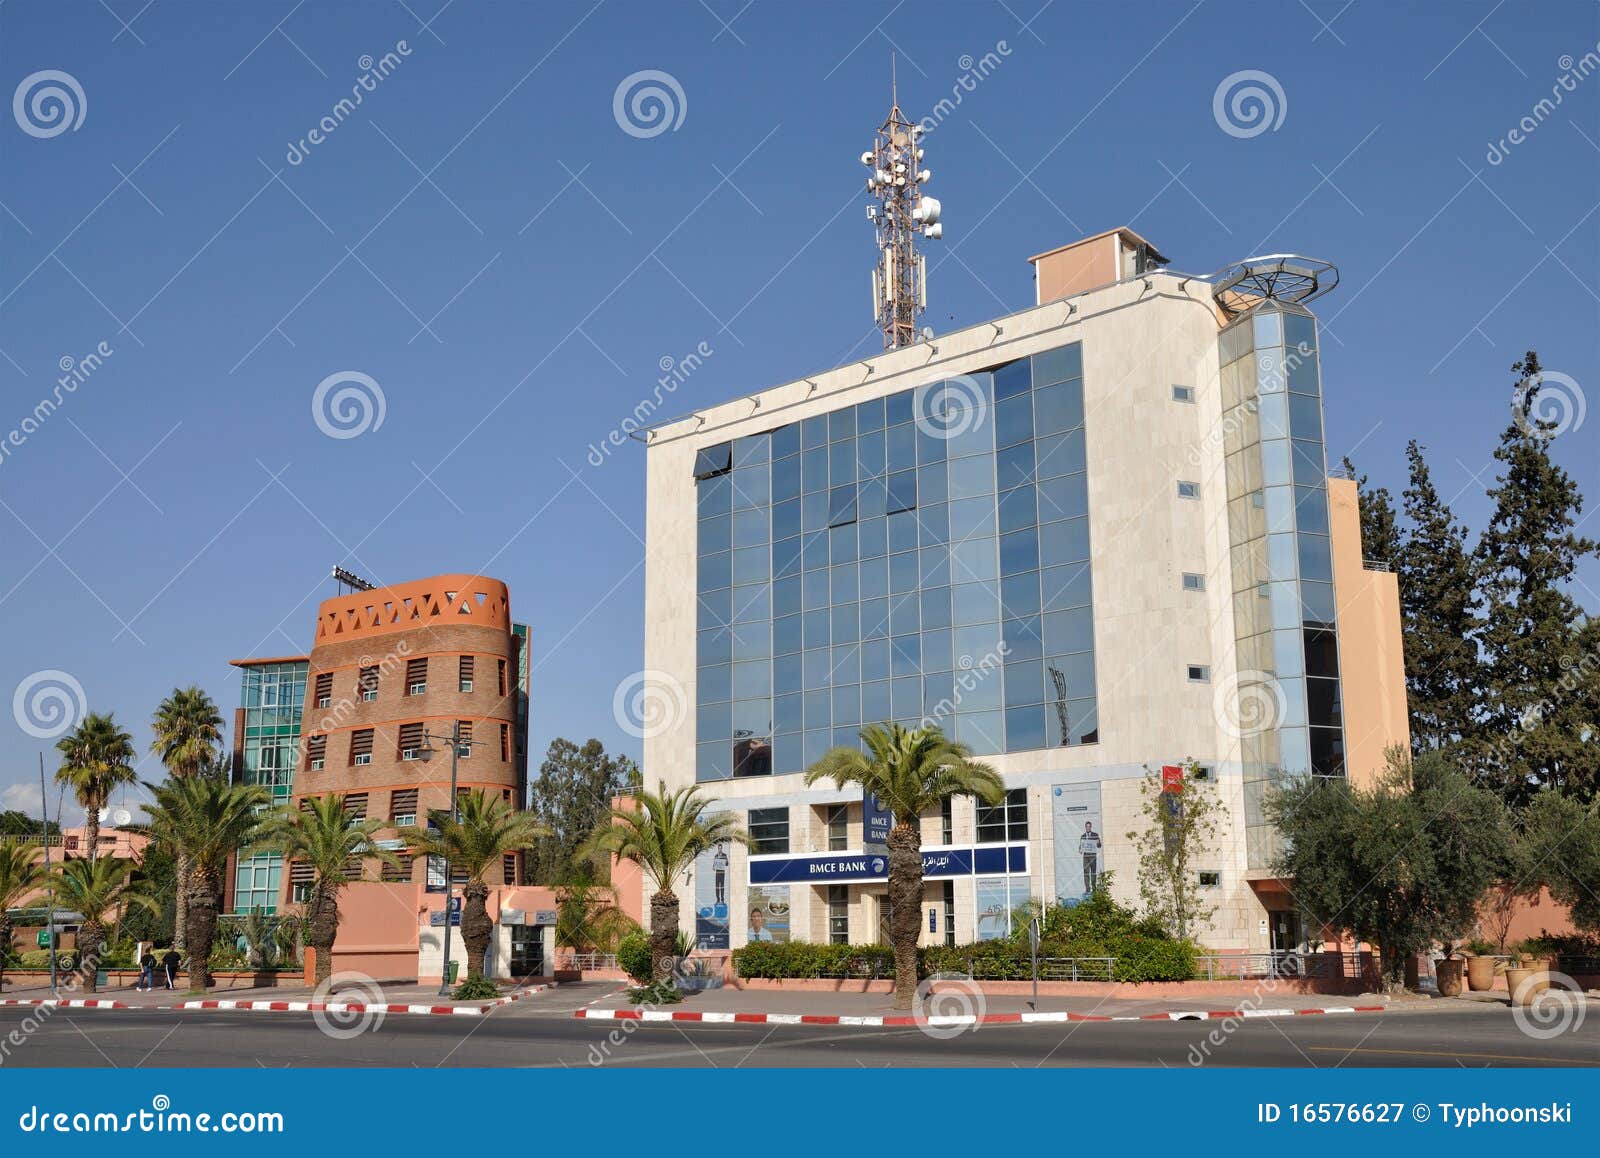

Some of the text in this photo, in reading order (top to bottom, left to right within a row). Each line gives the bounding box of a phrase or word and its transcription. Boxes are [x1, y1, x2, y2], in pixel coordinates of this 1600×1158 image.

[871, 817, 887, 826] BMCE
[871, 830, 888, 839] BANK
[809, 861, 866, 873] BMCE BANK
